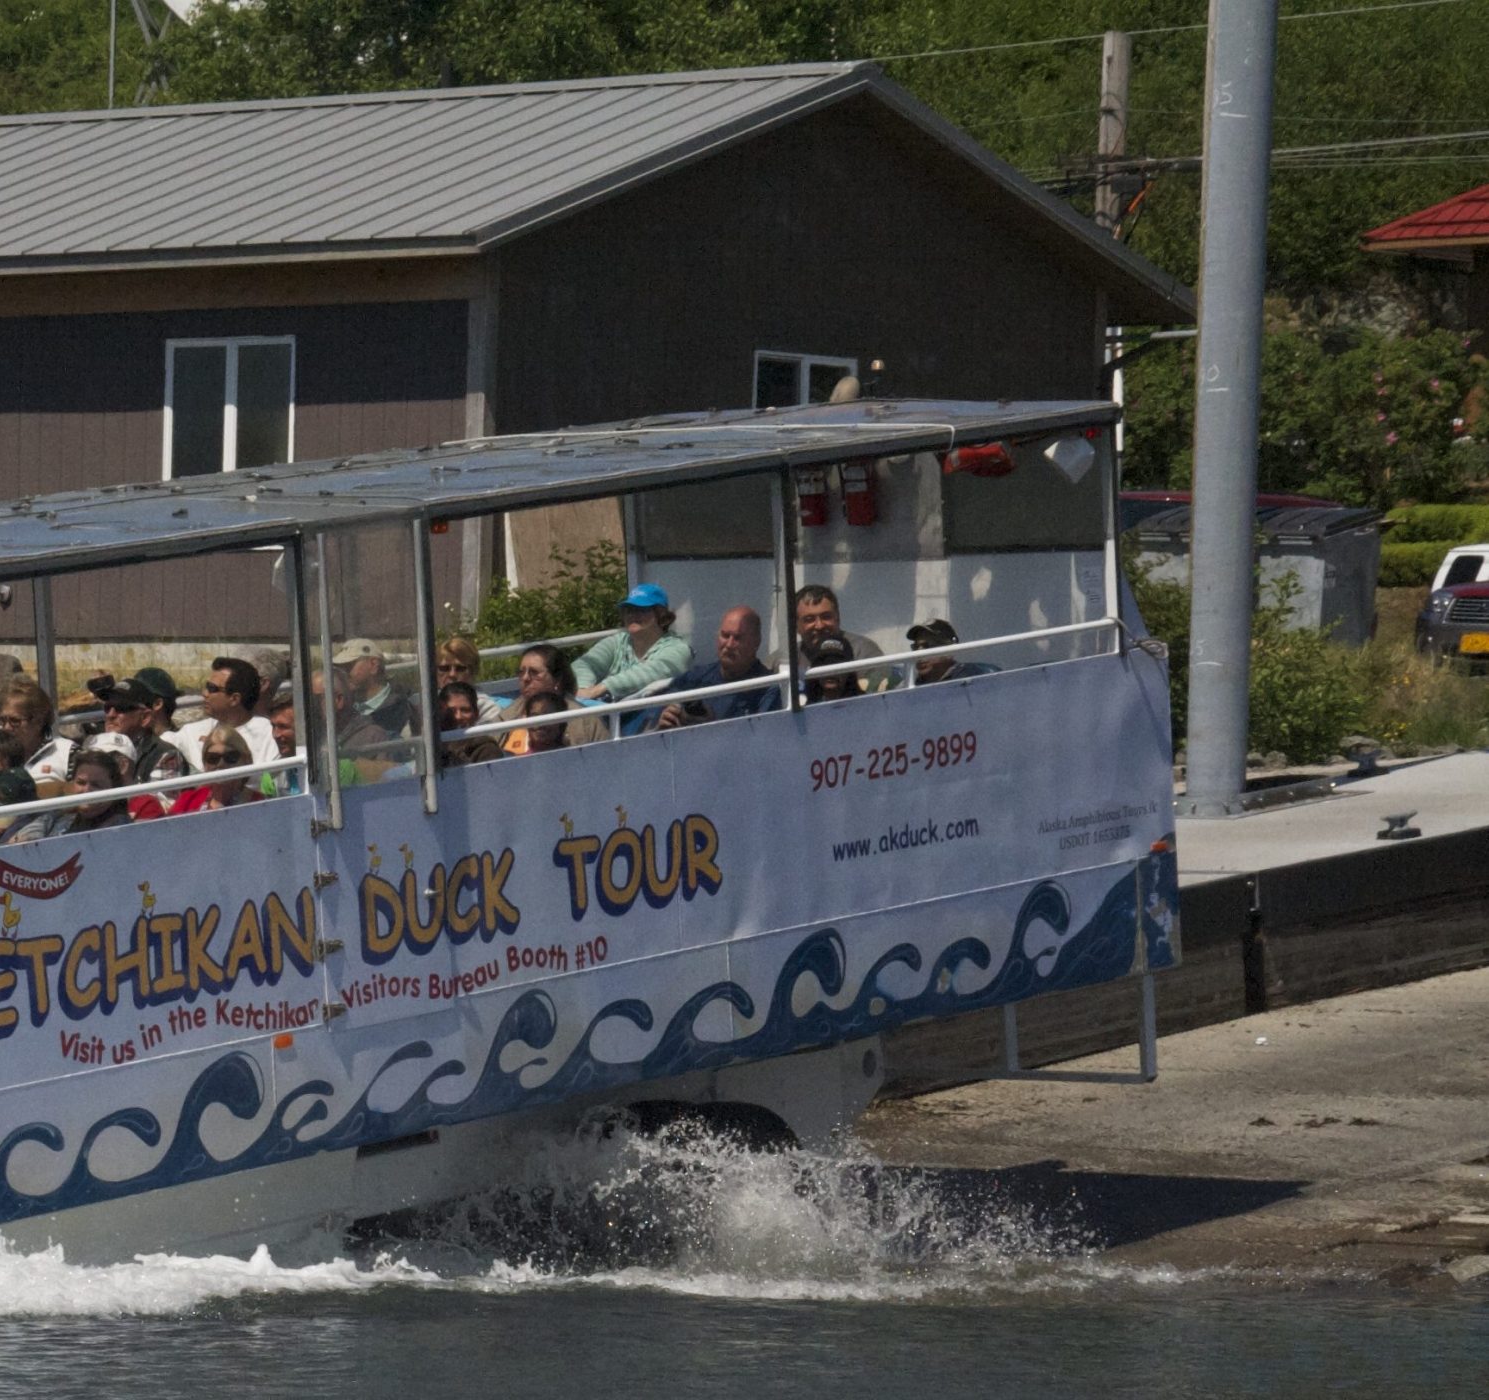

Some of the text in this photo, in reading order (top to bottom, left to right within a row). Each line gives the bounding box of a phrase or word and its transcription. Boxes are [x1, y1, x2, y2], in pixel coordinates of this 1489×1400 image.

[811, 731, 977, 792] 907-225-9899
[832, 817, 979, 862] www.akduck.com
[2, 871, 70, 892] EVERYONE!
[359, 846, 521, 966] DUCK
[554, 814, 723, 921] TOUR
[60, 1029, 105, 1064] Visit
[111, 1040, 136, 1064] us
[140, 1023, 163, 1050] in
[168, 1005, 207, 1036] the
[341, 974, 421, 1009] Visitors
[428, 959, 499, 1000] Bureau
[506, 945, 568, 972] Booth
[575, 935, 609, 970] #10
